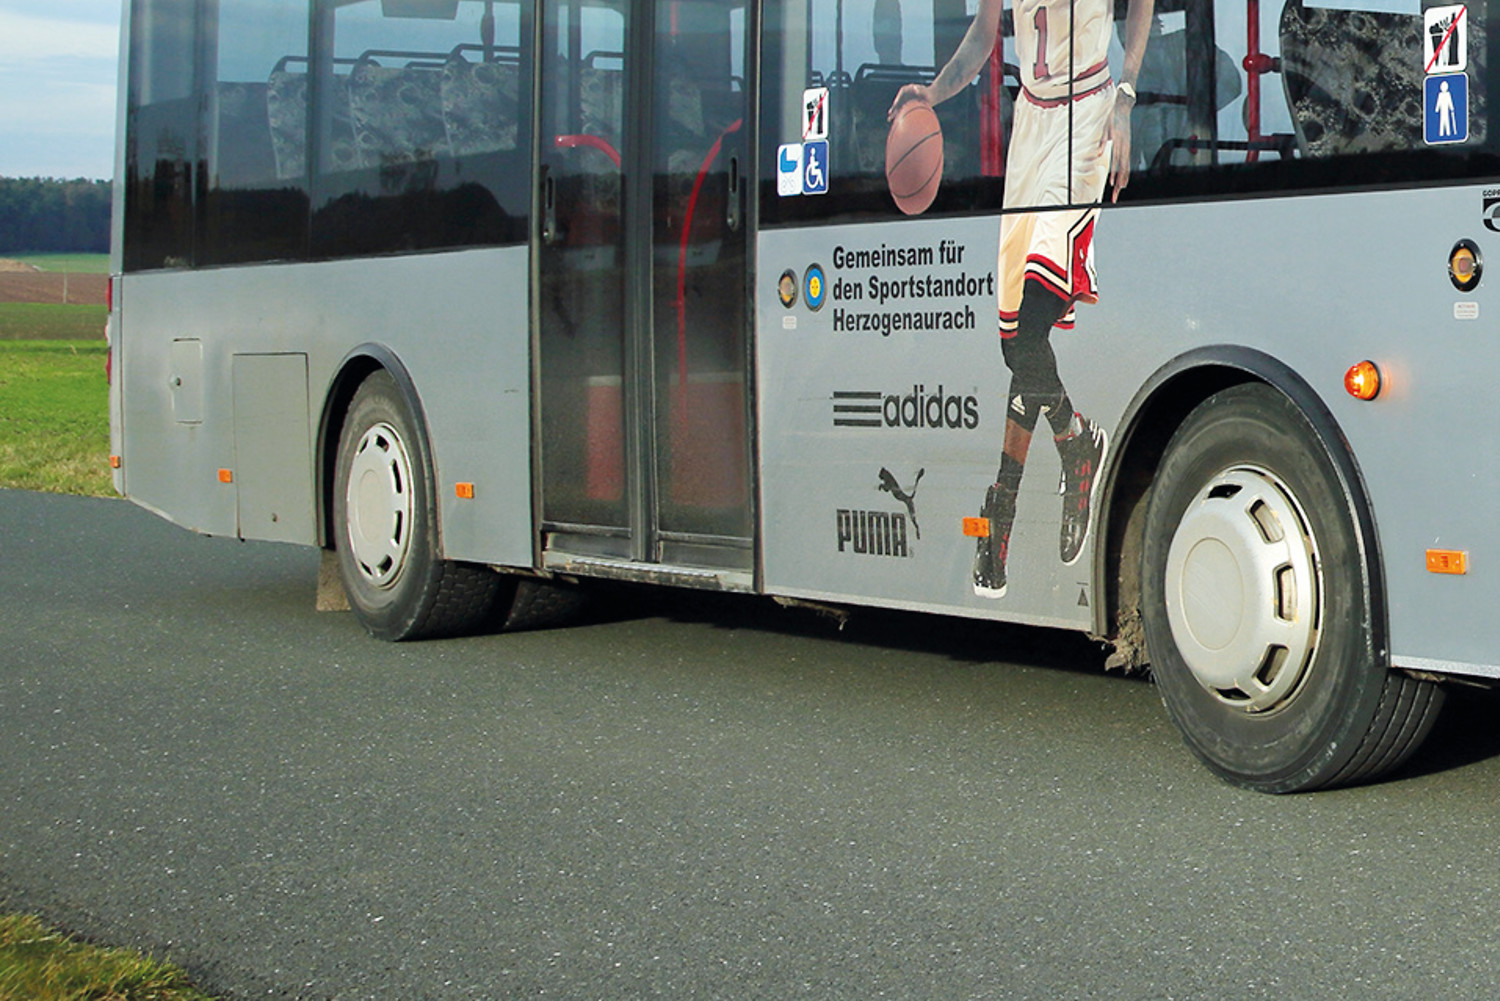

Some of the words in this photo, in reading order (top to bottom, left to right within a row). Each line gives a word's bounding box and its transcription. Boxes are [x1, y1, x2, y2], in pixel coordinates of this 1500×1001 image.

[1033, 6, 1049, 80] 1
[832, 243, 935, 270] Gemeinsam
[939, 240, 966, 265] für
[832, 277, 863, 300] den
[869, 271, 994, 305] Sportstandort
[832, 304, 976, 336] Herzogenaurach
[883, 384, 980, 430] adidas
[836, 508, 908, 557] PUMA
